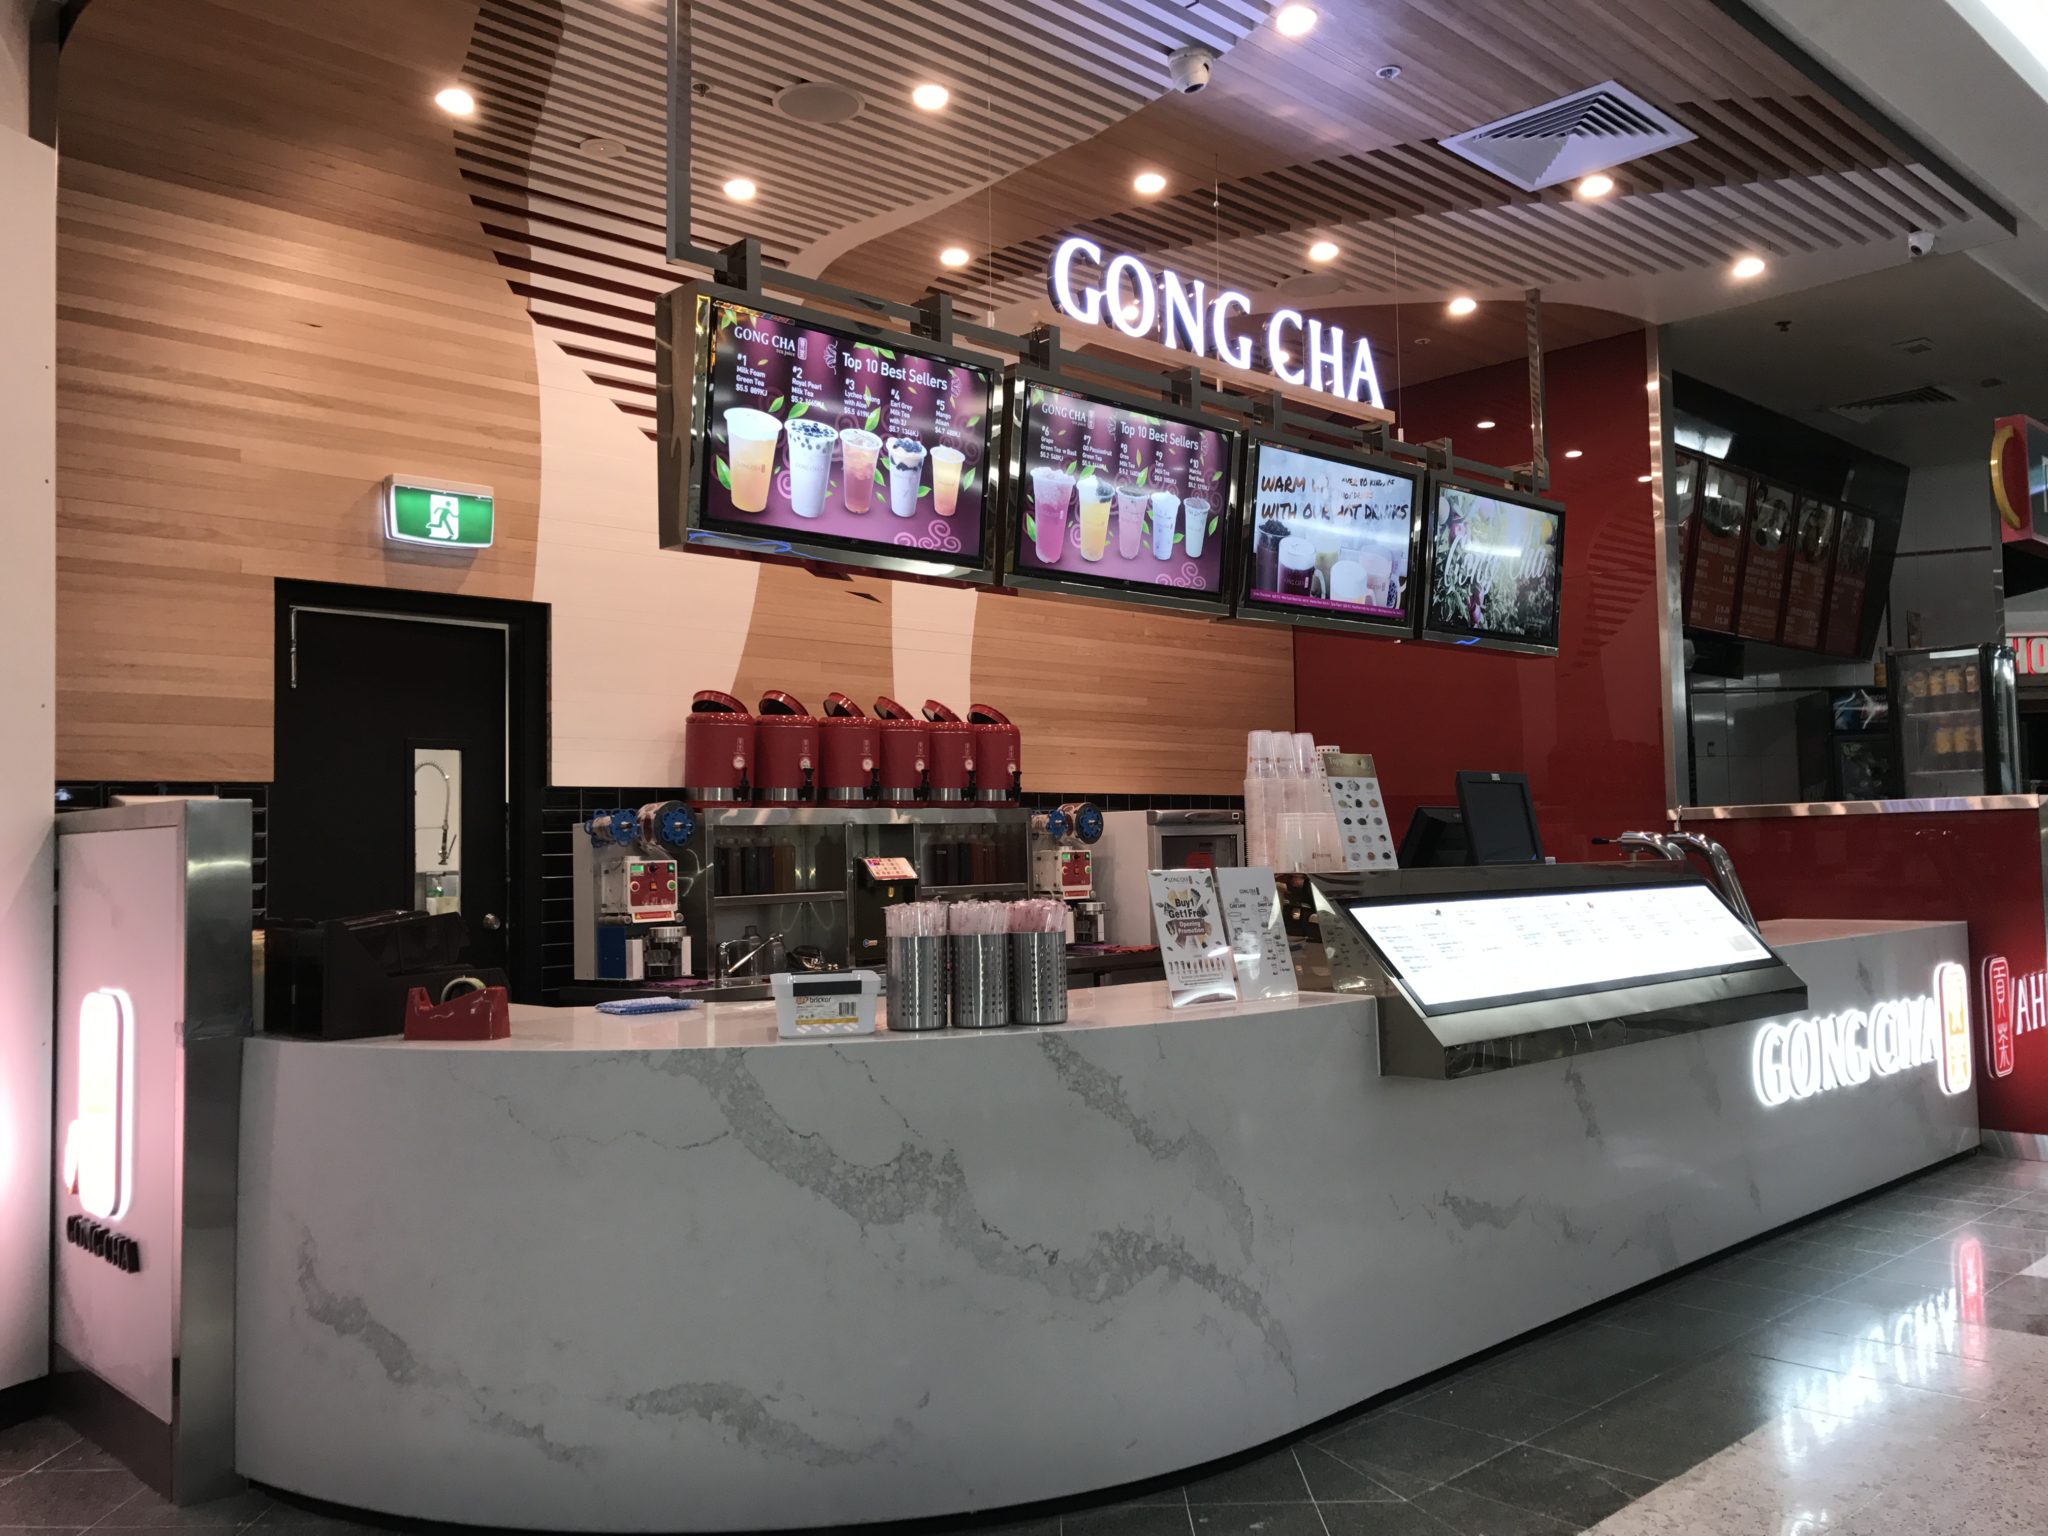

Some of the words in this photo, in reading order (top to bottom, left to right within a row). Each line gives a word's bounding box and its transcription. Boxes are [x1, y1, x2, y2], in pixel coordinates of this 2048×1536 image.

[1052, 237, 1253, 370] GONG
[1267, 309, 1385, 410] CHA
[734, 326, 769, 345] GONG
[771, 335, 796, 352] CHA
[735, 374, 754, 385] Green
[754, 377, 765, 387] Tea
[736, 365, 749, 375] Milk
[749, 368, 766, 378] Foam
[842, 352, 862, 373] Top
[865, 358, 878, 374] 10
[880, 362, 906, 380] Best
[908, 369, 948, 391] Sellers
[791, 377, 806, 388] Royal
[791, 386, 804, 395] Milk
[804, 389, 814, 397] Tea
[844, 390, 863, 400] Lychee
[1041, 402, 1067, 418] GONG
[1068, 409, 1087, 423] CHA
[1119, 421, 1135, 438] Top
[1137, 425, 1147, 439] 10
[1148, 428, 1168, 444] Best
[1169, 433, 1199, 451] Sellers
[1261, 475, 1306, 493] WARM
[1261, 502, 1297, 520] WITH
[1364, 503, 1409, 520] DRKS
[1754, 1008, 1871, 1106] GONG
